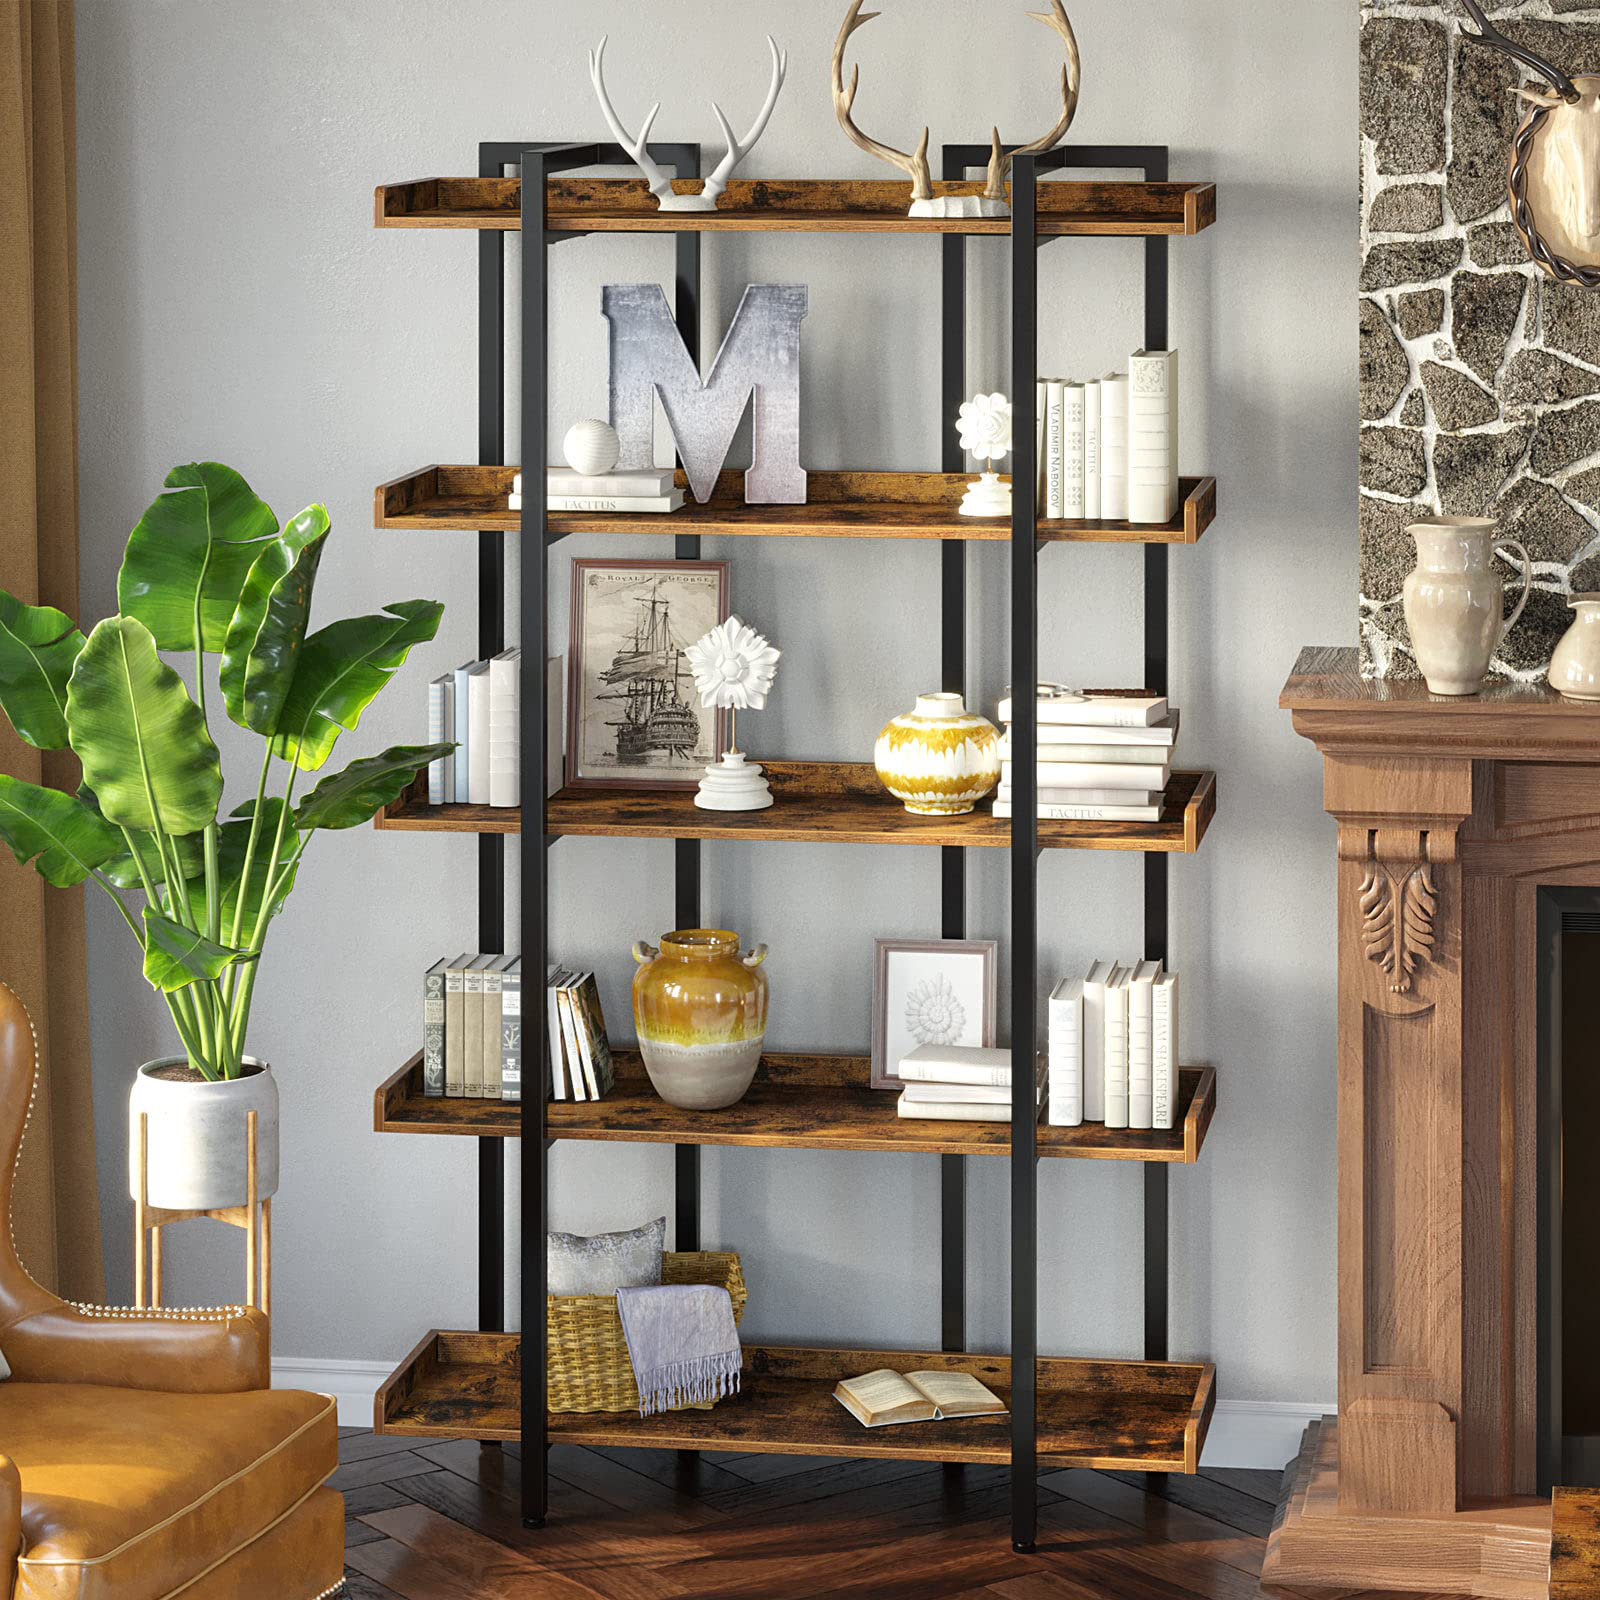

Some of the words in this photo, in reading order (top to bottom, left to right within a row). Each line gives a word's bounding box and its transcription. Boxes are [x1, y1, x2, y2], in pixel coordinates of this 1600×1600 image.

[601, 284, 808, 504] M
[1050, 403, 1061, 454] VLADIMIR
[564, 500, 617, 510] TACITUS
[1050, 456, 1061, 508] NABOKOV
[1048, 808, 1104, 819] TACITUS
[1156, 988, 1168, 1041] WILLIAM
[1155, 1045, 1168, 1125] SHAKESPEARE
